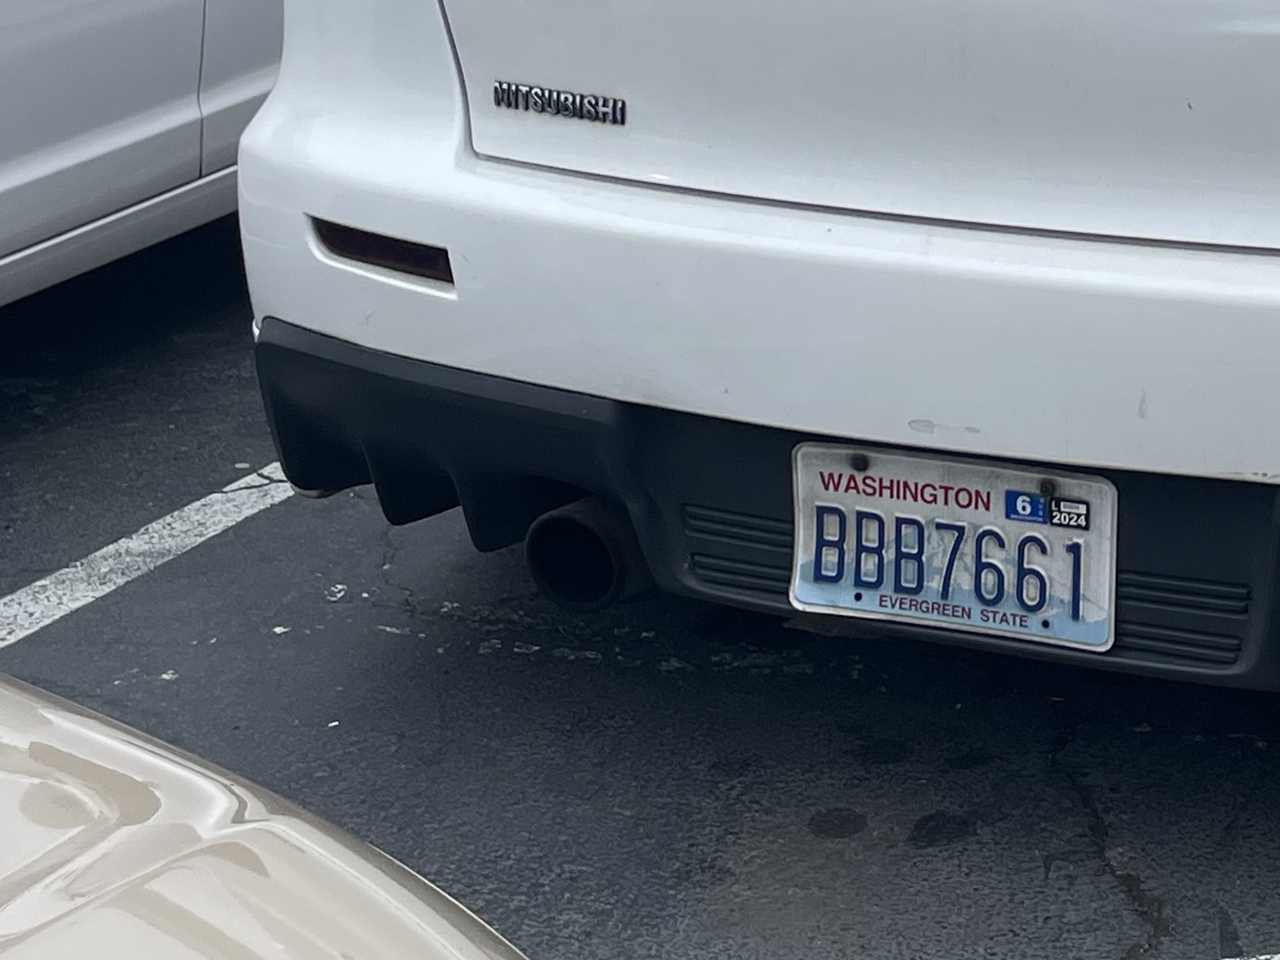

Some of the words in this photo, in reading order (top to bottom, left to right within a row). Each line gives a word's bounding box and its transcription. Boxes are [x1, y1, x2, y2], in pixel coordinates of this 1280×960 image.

[493, 80, 626, 125] MITSUBISHI
[819, 471, 992, 512] WASHINGTON
[1016, 494, 1032, 516] 6
[1052, 511, 1087, 527] 2024
[813, 503, 1084, 621] BBB7661
[878, 594, 972, 619] EVERGREEN
[980, 608, 1030, 628] STATE
